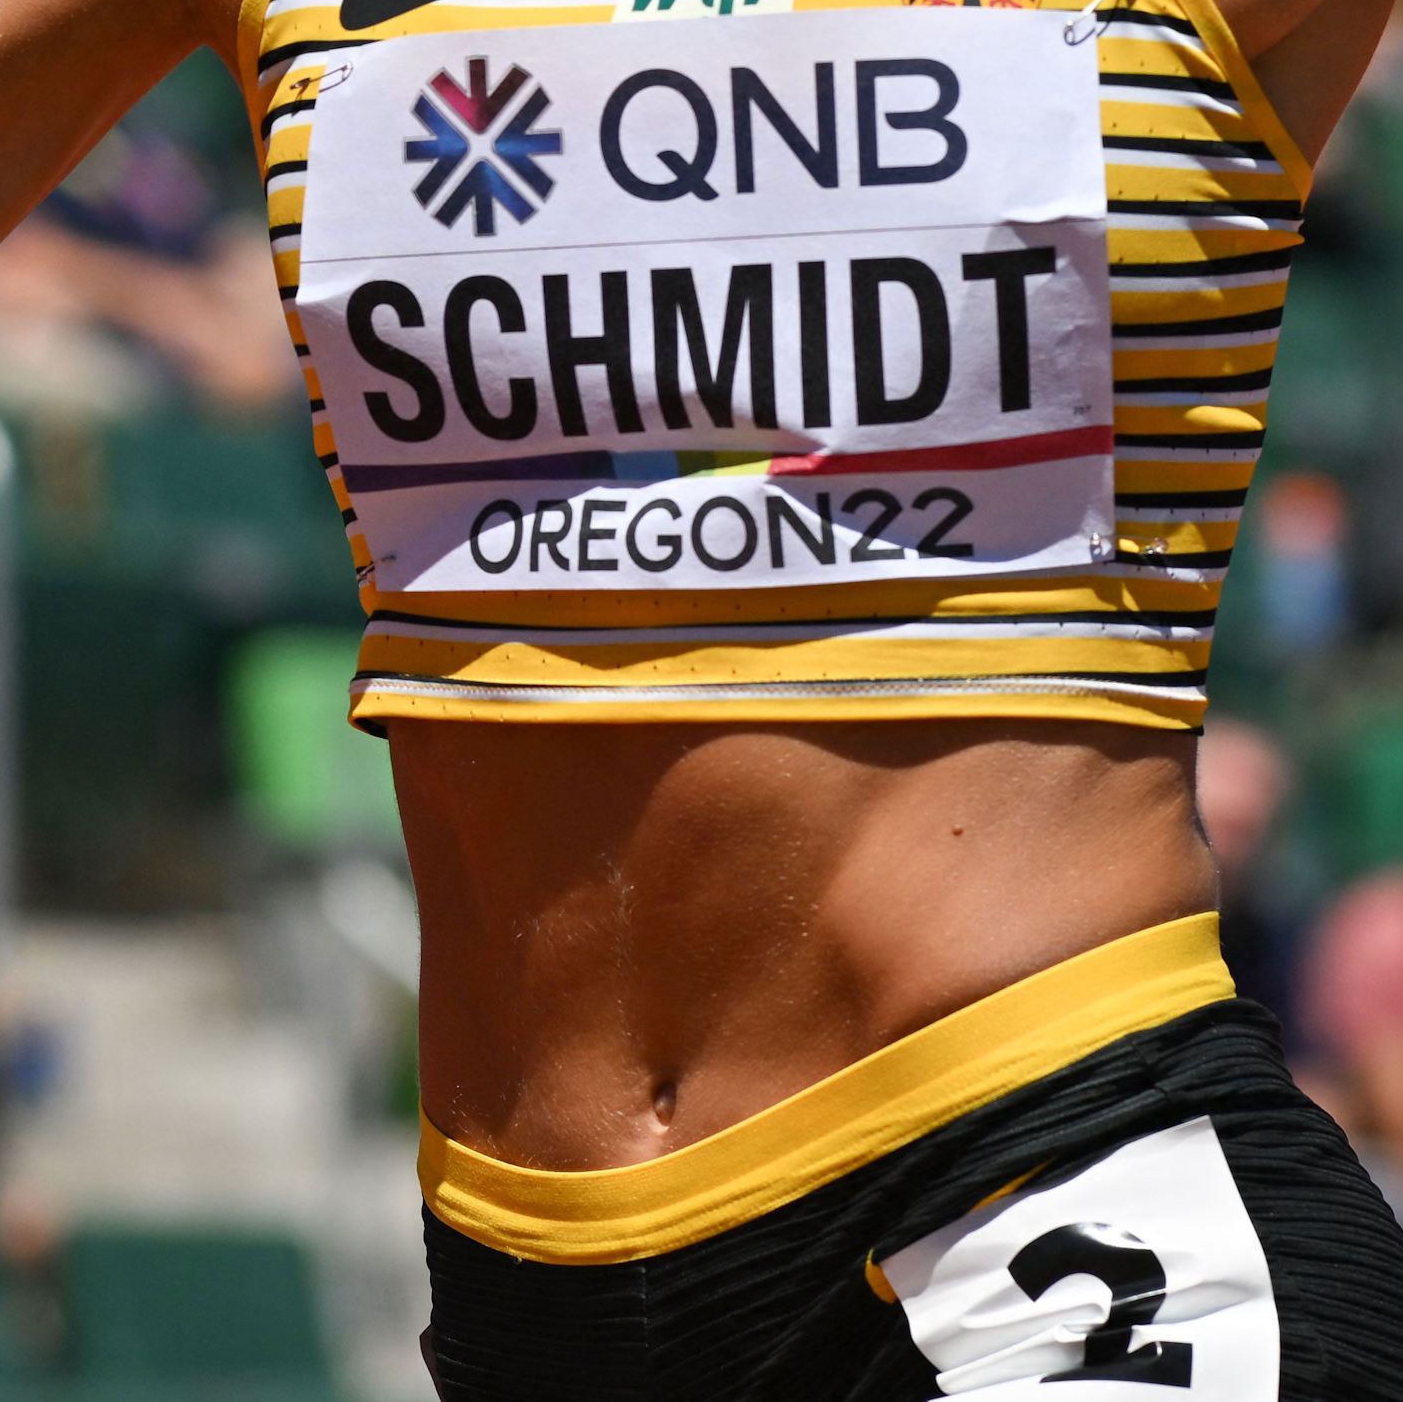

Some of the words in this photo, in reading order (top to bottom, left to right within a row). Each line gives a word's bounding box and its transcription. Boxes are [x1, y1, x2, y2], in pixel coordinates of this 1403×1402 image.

[599, 58, 969, 200] QNB
[346, 246, 1057, 443] SCHMIDT
[469, 488, 975, 574] OREGON22
[1008, 1222, 1194, 1388] 2
